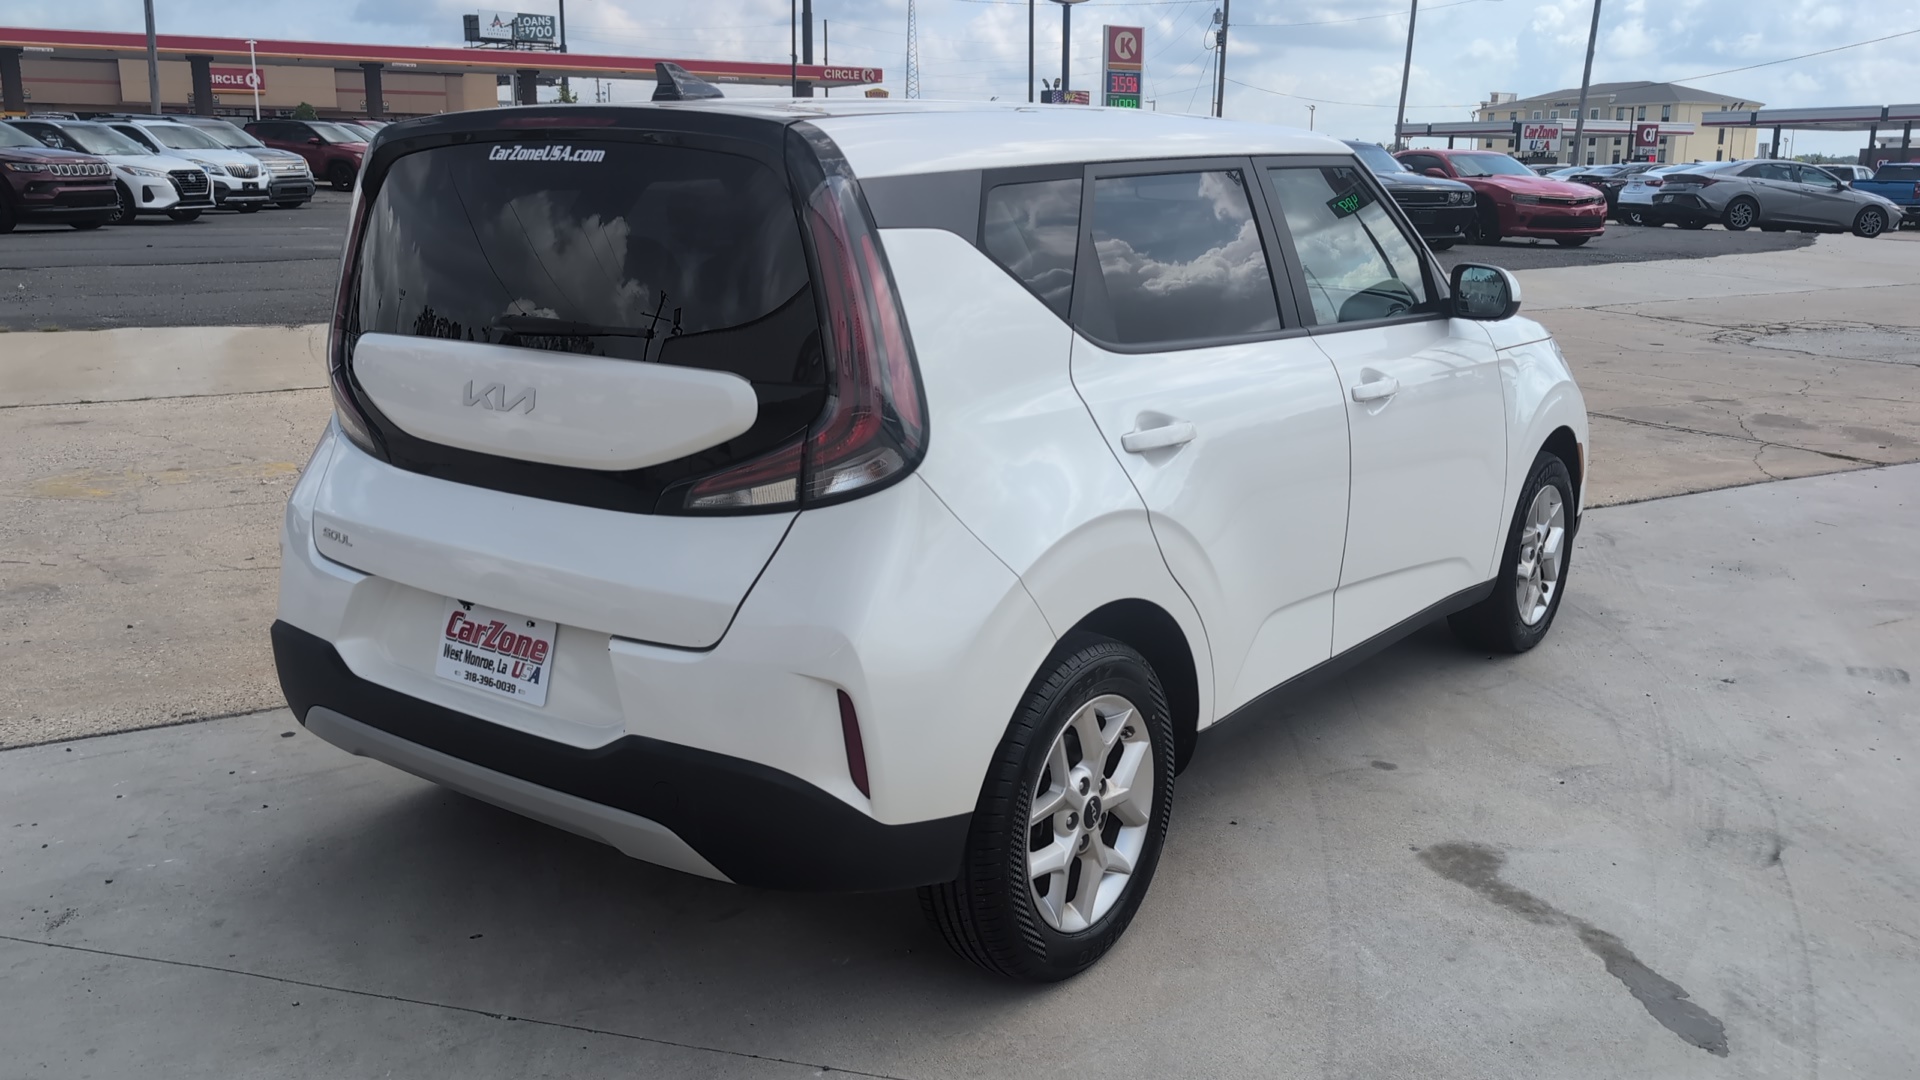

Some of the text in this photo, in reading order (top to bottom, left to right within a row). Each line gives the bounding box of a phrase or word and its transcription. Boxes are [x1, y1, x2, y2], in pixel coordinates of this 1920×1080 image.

[518, 16, 552, 27] LOANS
[525, 26, 553, 38] $700
[211, 74, 244, 84] IRCLE
[824, 69, 859, 79] CIRCLE
[1524, 125, 1558, 139] CarZone
[488, 145, 606, 162] CarZoneUSA.com
[463, 379, 536, 415] KIA
[323, 526, 353, 547] SOUL
[445, 610, 550, 666] CarZone
[443, 643, 508, 675] West Monroe, La
[464, 670, 517, 694] 318-396-0039
[511, 660, 542, 685] USA
